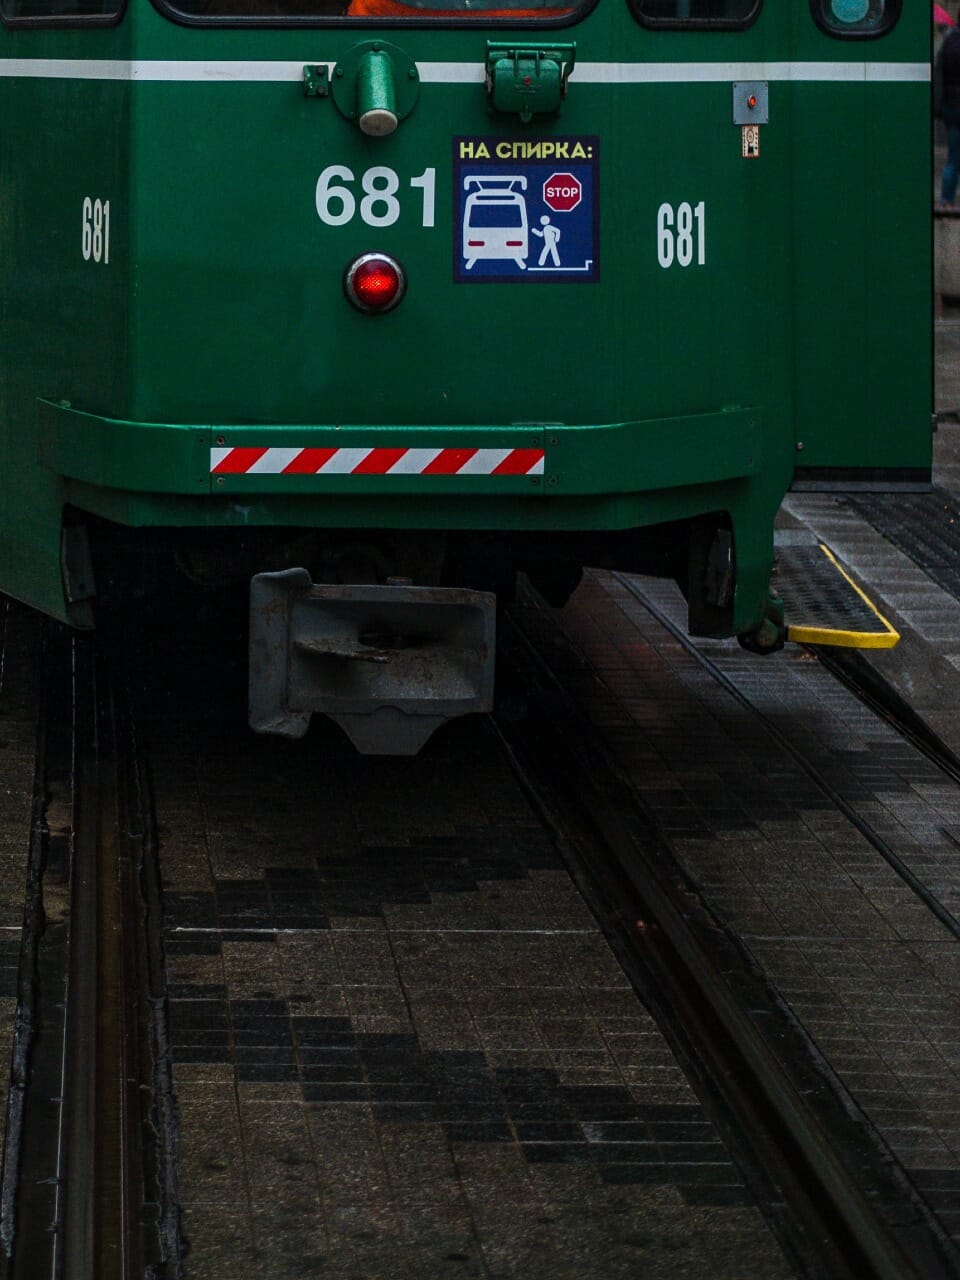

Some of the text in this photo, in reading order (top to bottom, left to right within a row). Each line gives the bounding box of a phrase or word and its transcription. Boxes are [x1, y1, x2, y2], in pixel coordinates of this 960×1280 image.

[459, 141, 593, 159] НА СПИРКА:
[315, 164, 436, 227] 681
[546, 186, 579, 198] STOP
[81, 196, 110, 265] 681
[657, 201, 706, 269] 681
